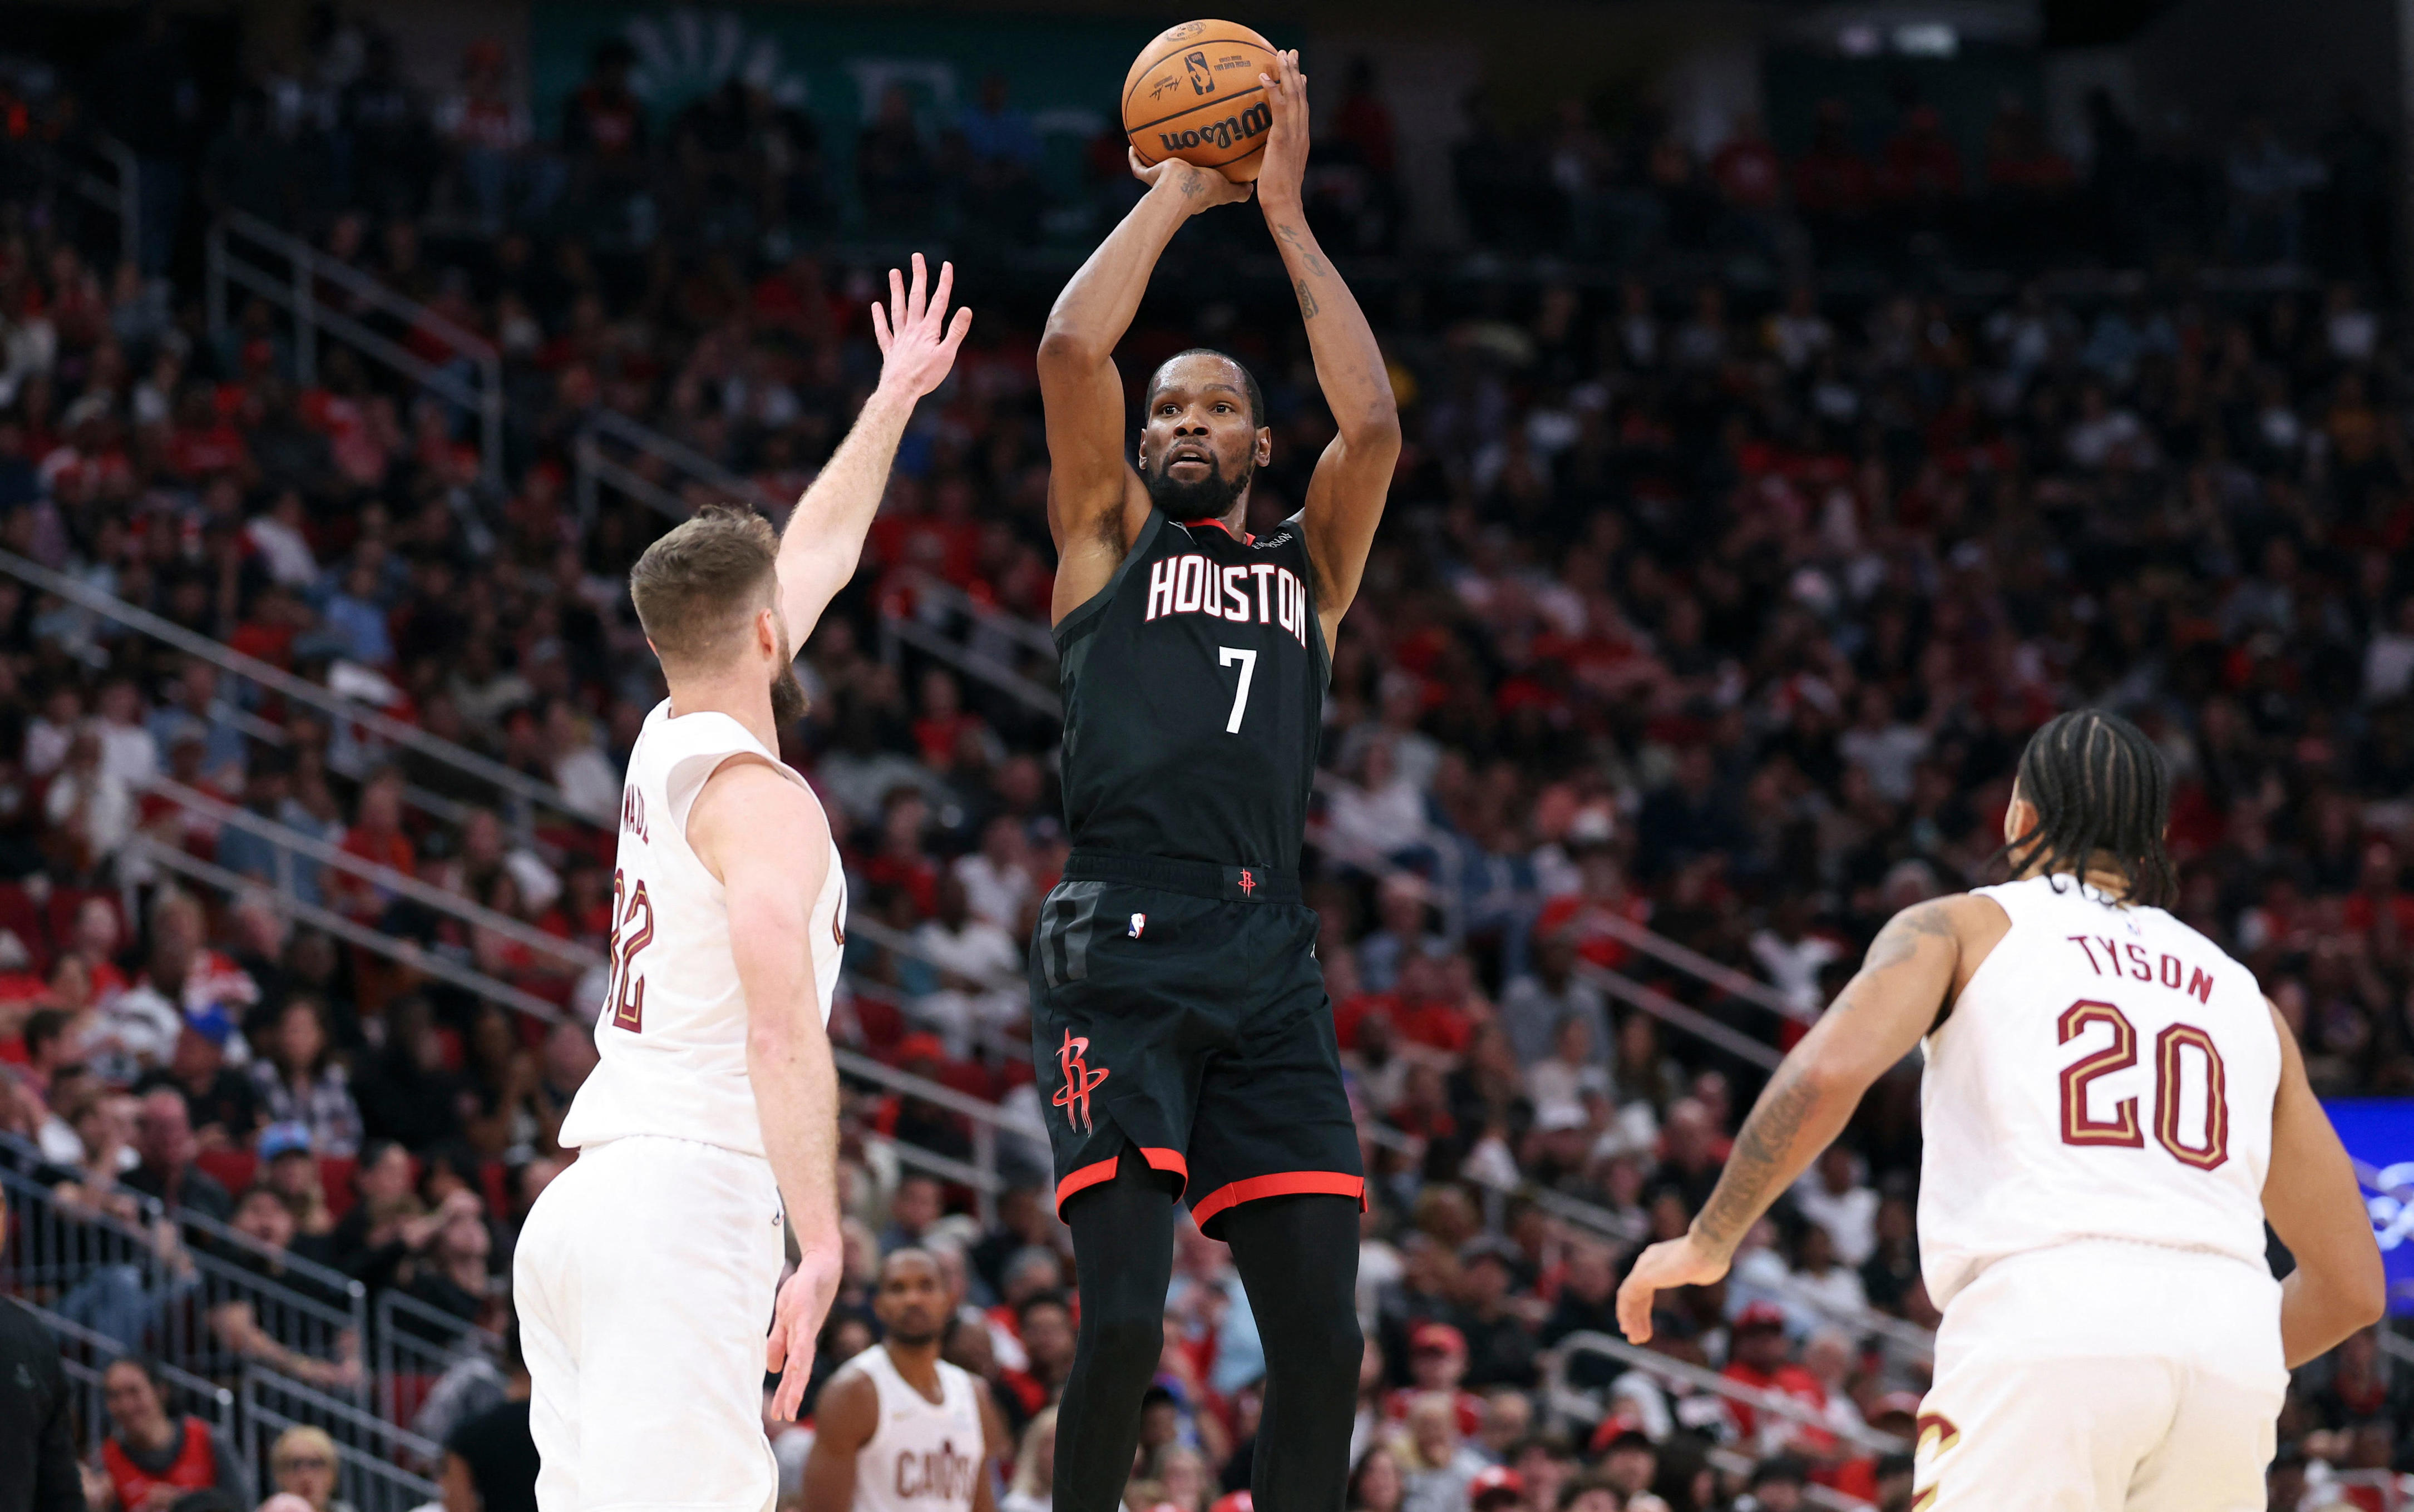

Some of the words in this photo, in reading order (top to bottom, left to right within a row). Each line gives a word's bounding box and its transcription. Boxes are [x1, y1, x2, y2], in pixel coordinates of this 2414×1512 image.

[1159, 102, 1273, 151] Wilson
[1144, 554, 1307, 650] HOUSTON
[1218, 646, 1257, 734] 7
[2067, 935, 2214, 1006] TYSON
[2057, 999, 2229, 1172] 20
